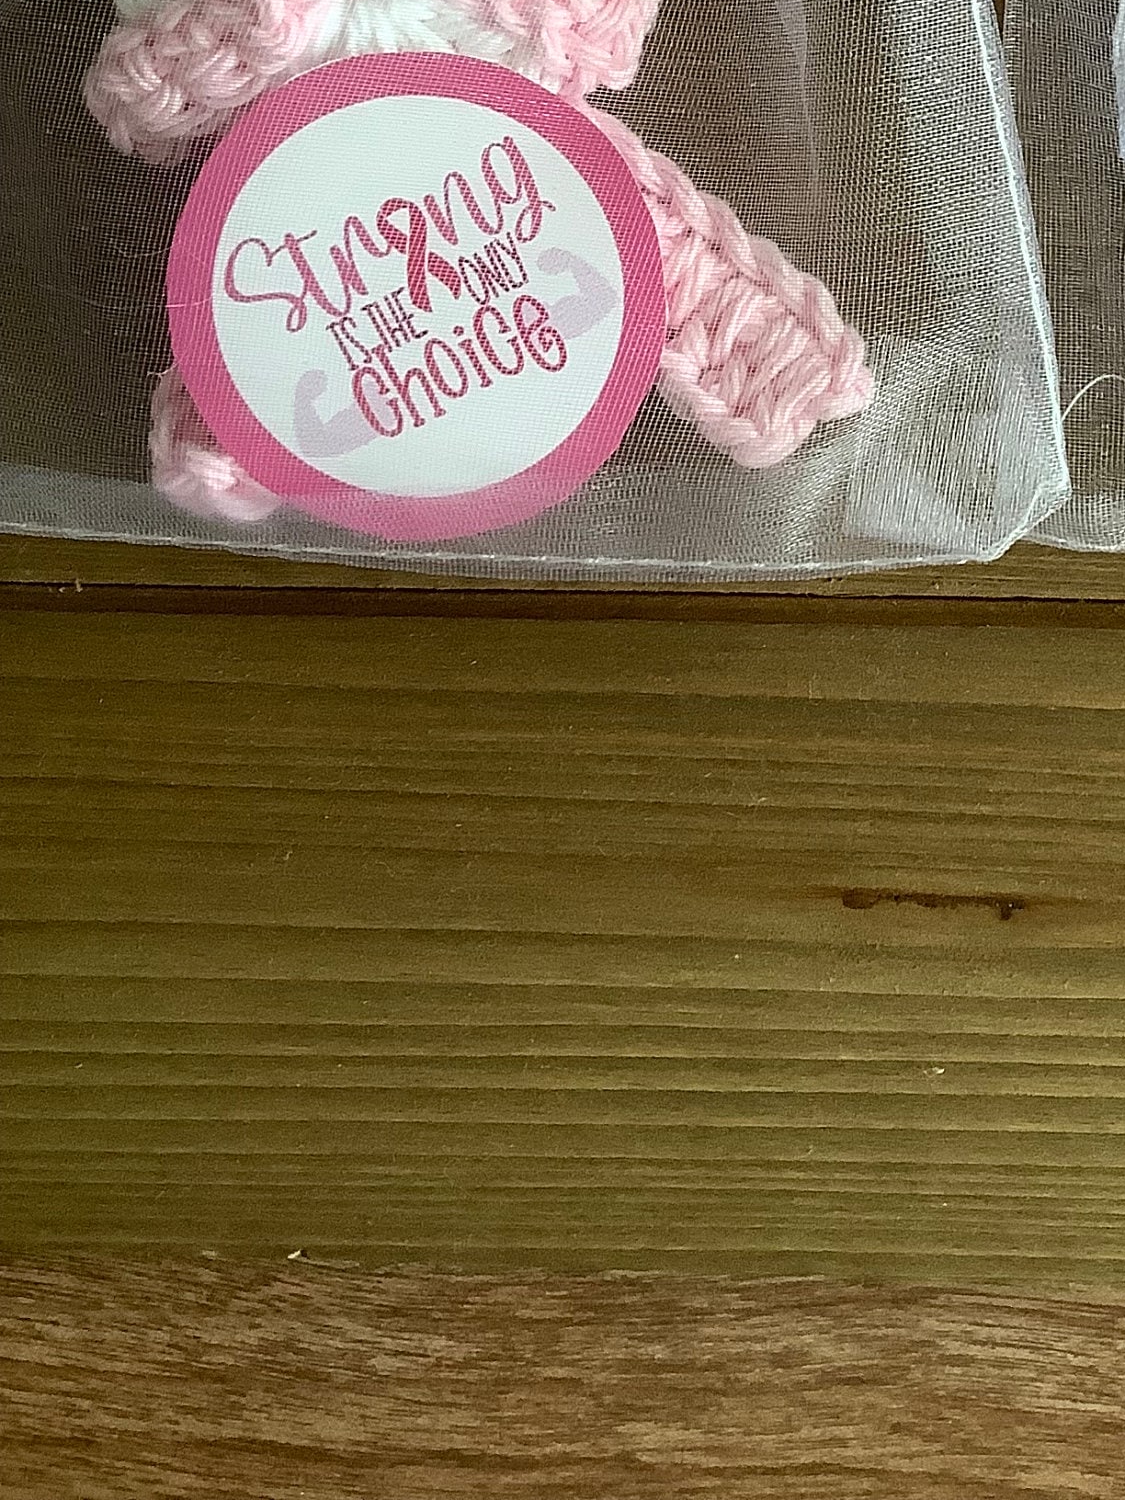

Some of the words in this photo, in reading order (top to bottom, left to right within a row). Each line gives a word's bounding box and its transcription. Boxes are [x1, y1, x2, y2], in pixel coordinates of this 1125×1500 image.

[224, 136, 555, 332] Strong
[326, 315, 372, 370] IS
[361, 286, 429, 356] THE
[458, 232, 529, 305] ONLY
